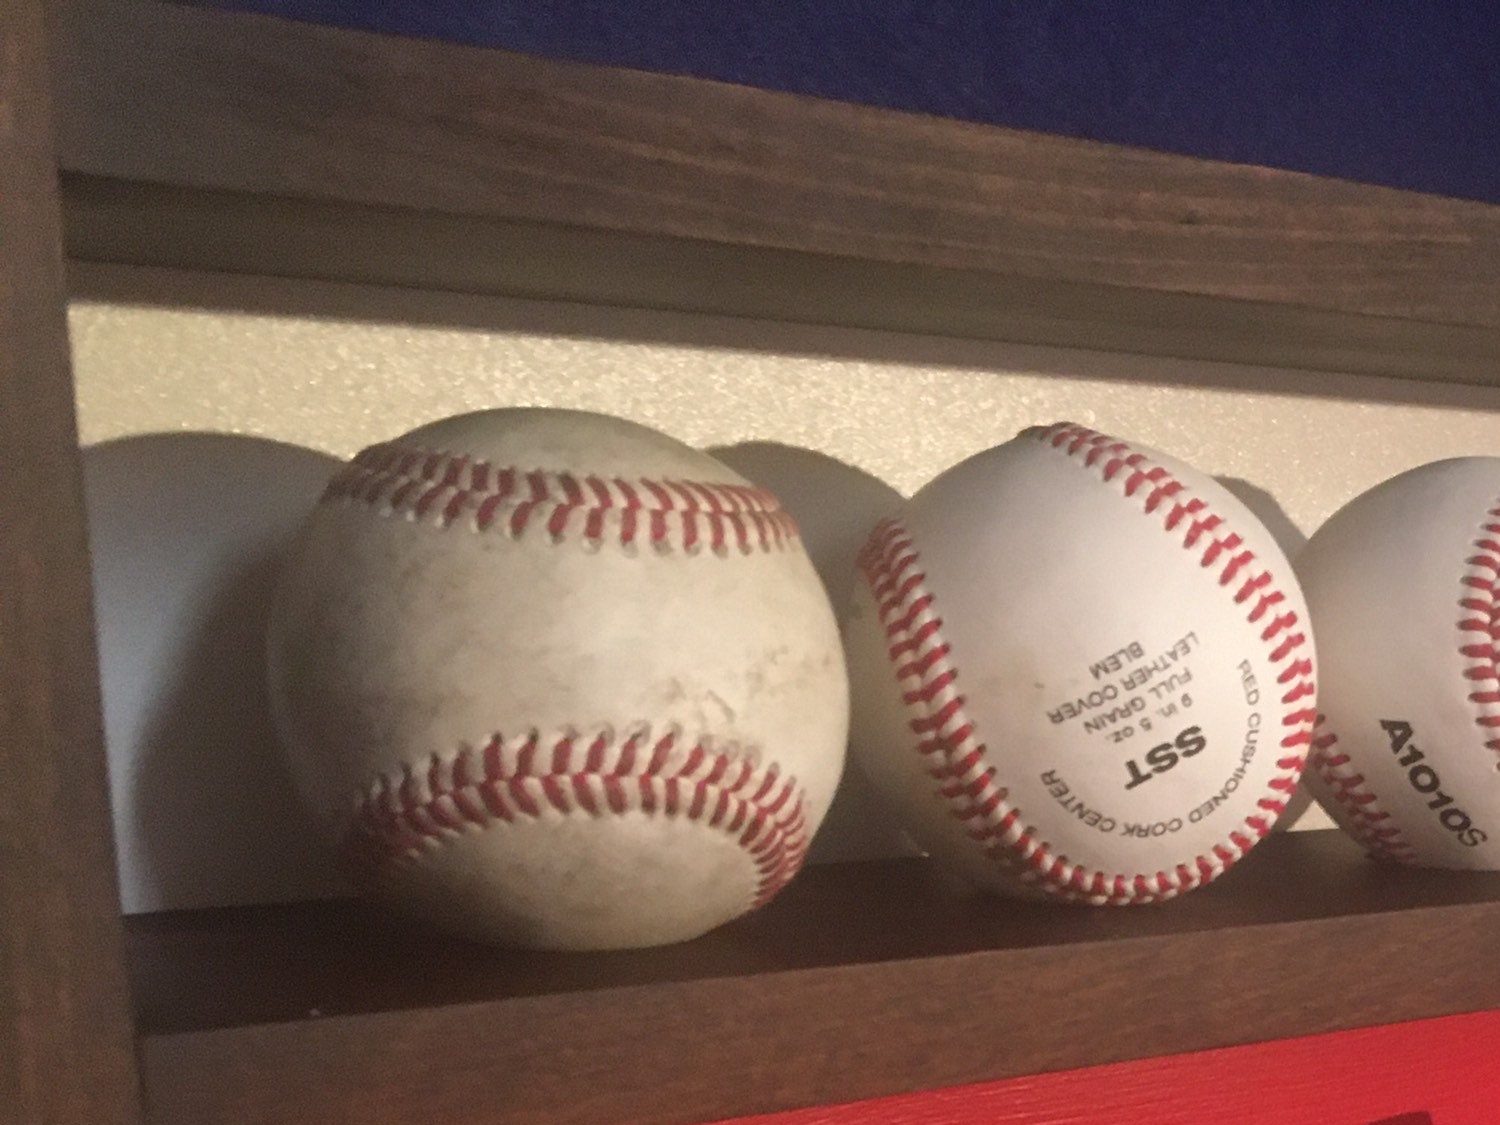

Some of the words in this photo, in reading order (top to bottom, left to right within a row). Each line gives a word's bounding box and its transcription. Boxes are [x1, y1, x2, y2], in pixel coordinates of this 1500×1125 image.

[1089, 641, 1145, 680] BLEM
[1119, 631, 1200, 691] LEATHER
[1047, 684, 1118, 724] COVER
[1148, 666, 1193, 699] FULL
[1237, 659, 1260, 706] RED
[1084, 696, 1146, 734] GRAIN
[1139, 717, 1152, 731] 5
[1124, 725, 1206, 790] SST
[1188, 712, 1261, 823] CUSHIONED
[1040, 768, 1116, 832] CENTER
[1379, 719, 1488, 847] A1010S
[1121, 817, 1183, 838] CORK
